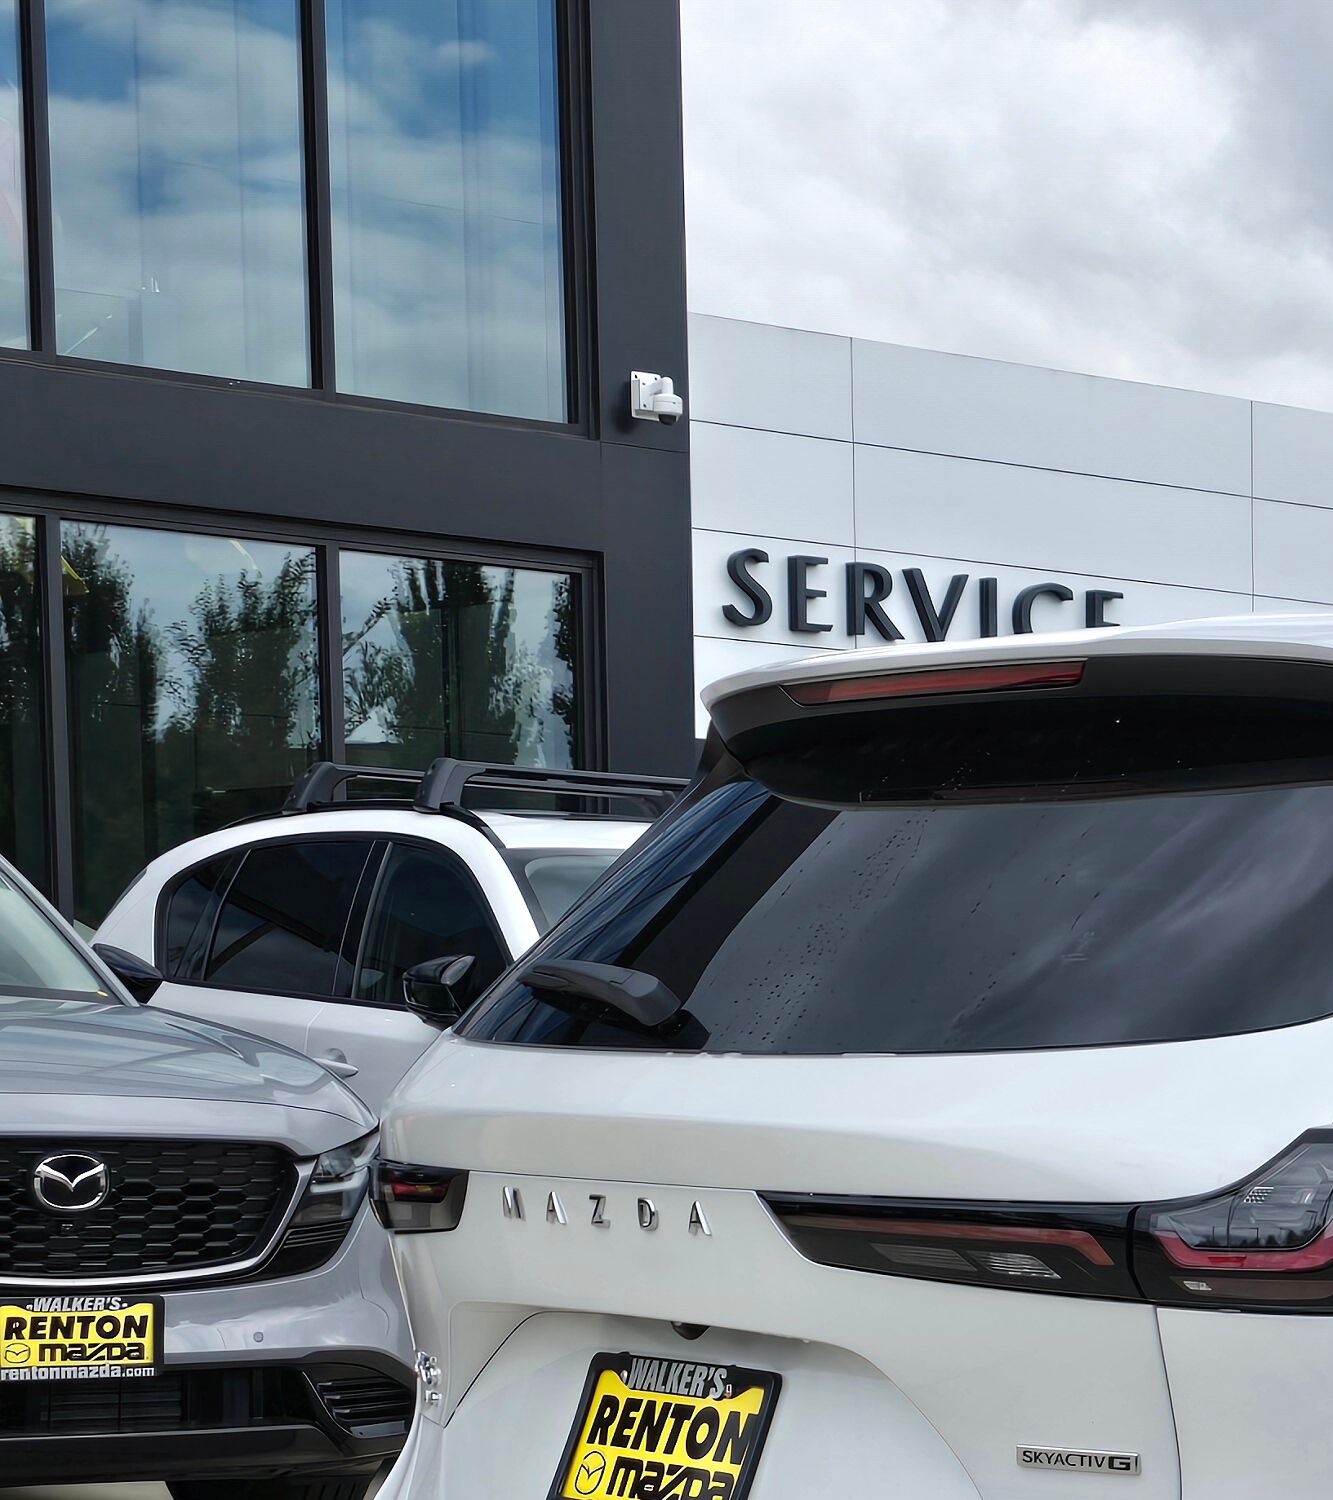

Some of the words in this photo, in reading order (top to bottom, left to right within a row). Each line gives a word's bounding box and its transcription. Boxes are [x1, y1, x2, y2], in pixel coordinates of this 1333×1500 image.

[721, 547, 1124, 643] SERVICE
[502, 1185, 713, 1237] MAZDA
[33, 1296, 122, 1312] WALKER'S
[4, 1315, 148, 1340] RENTON
[1, 1363, 155, 1382] rentonmazda.com
[627, 1357, 728, 1402] WALKER'S
[586, 1393, 758, 1466] RENTON
[1021, 1450, 1106, 1468] SKYACTIV
